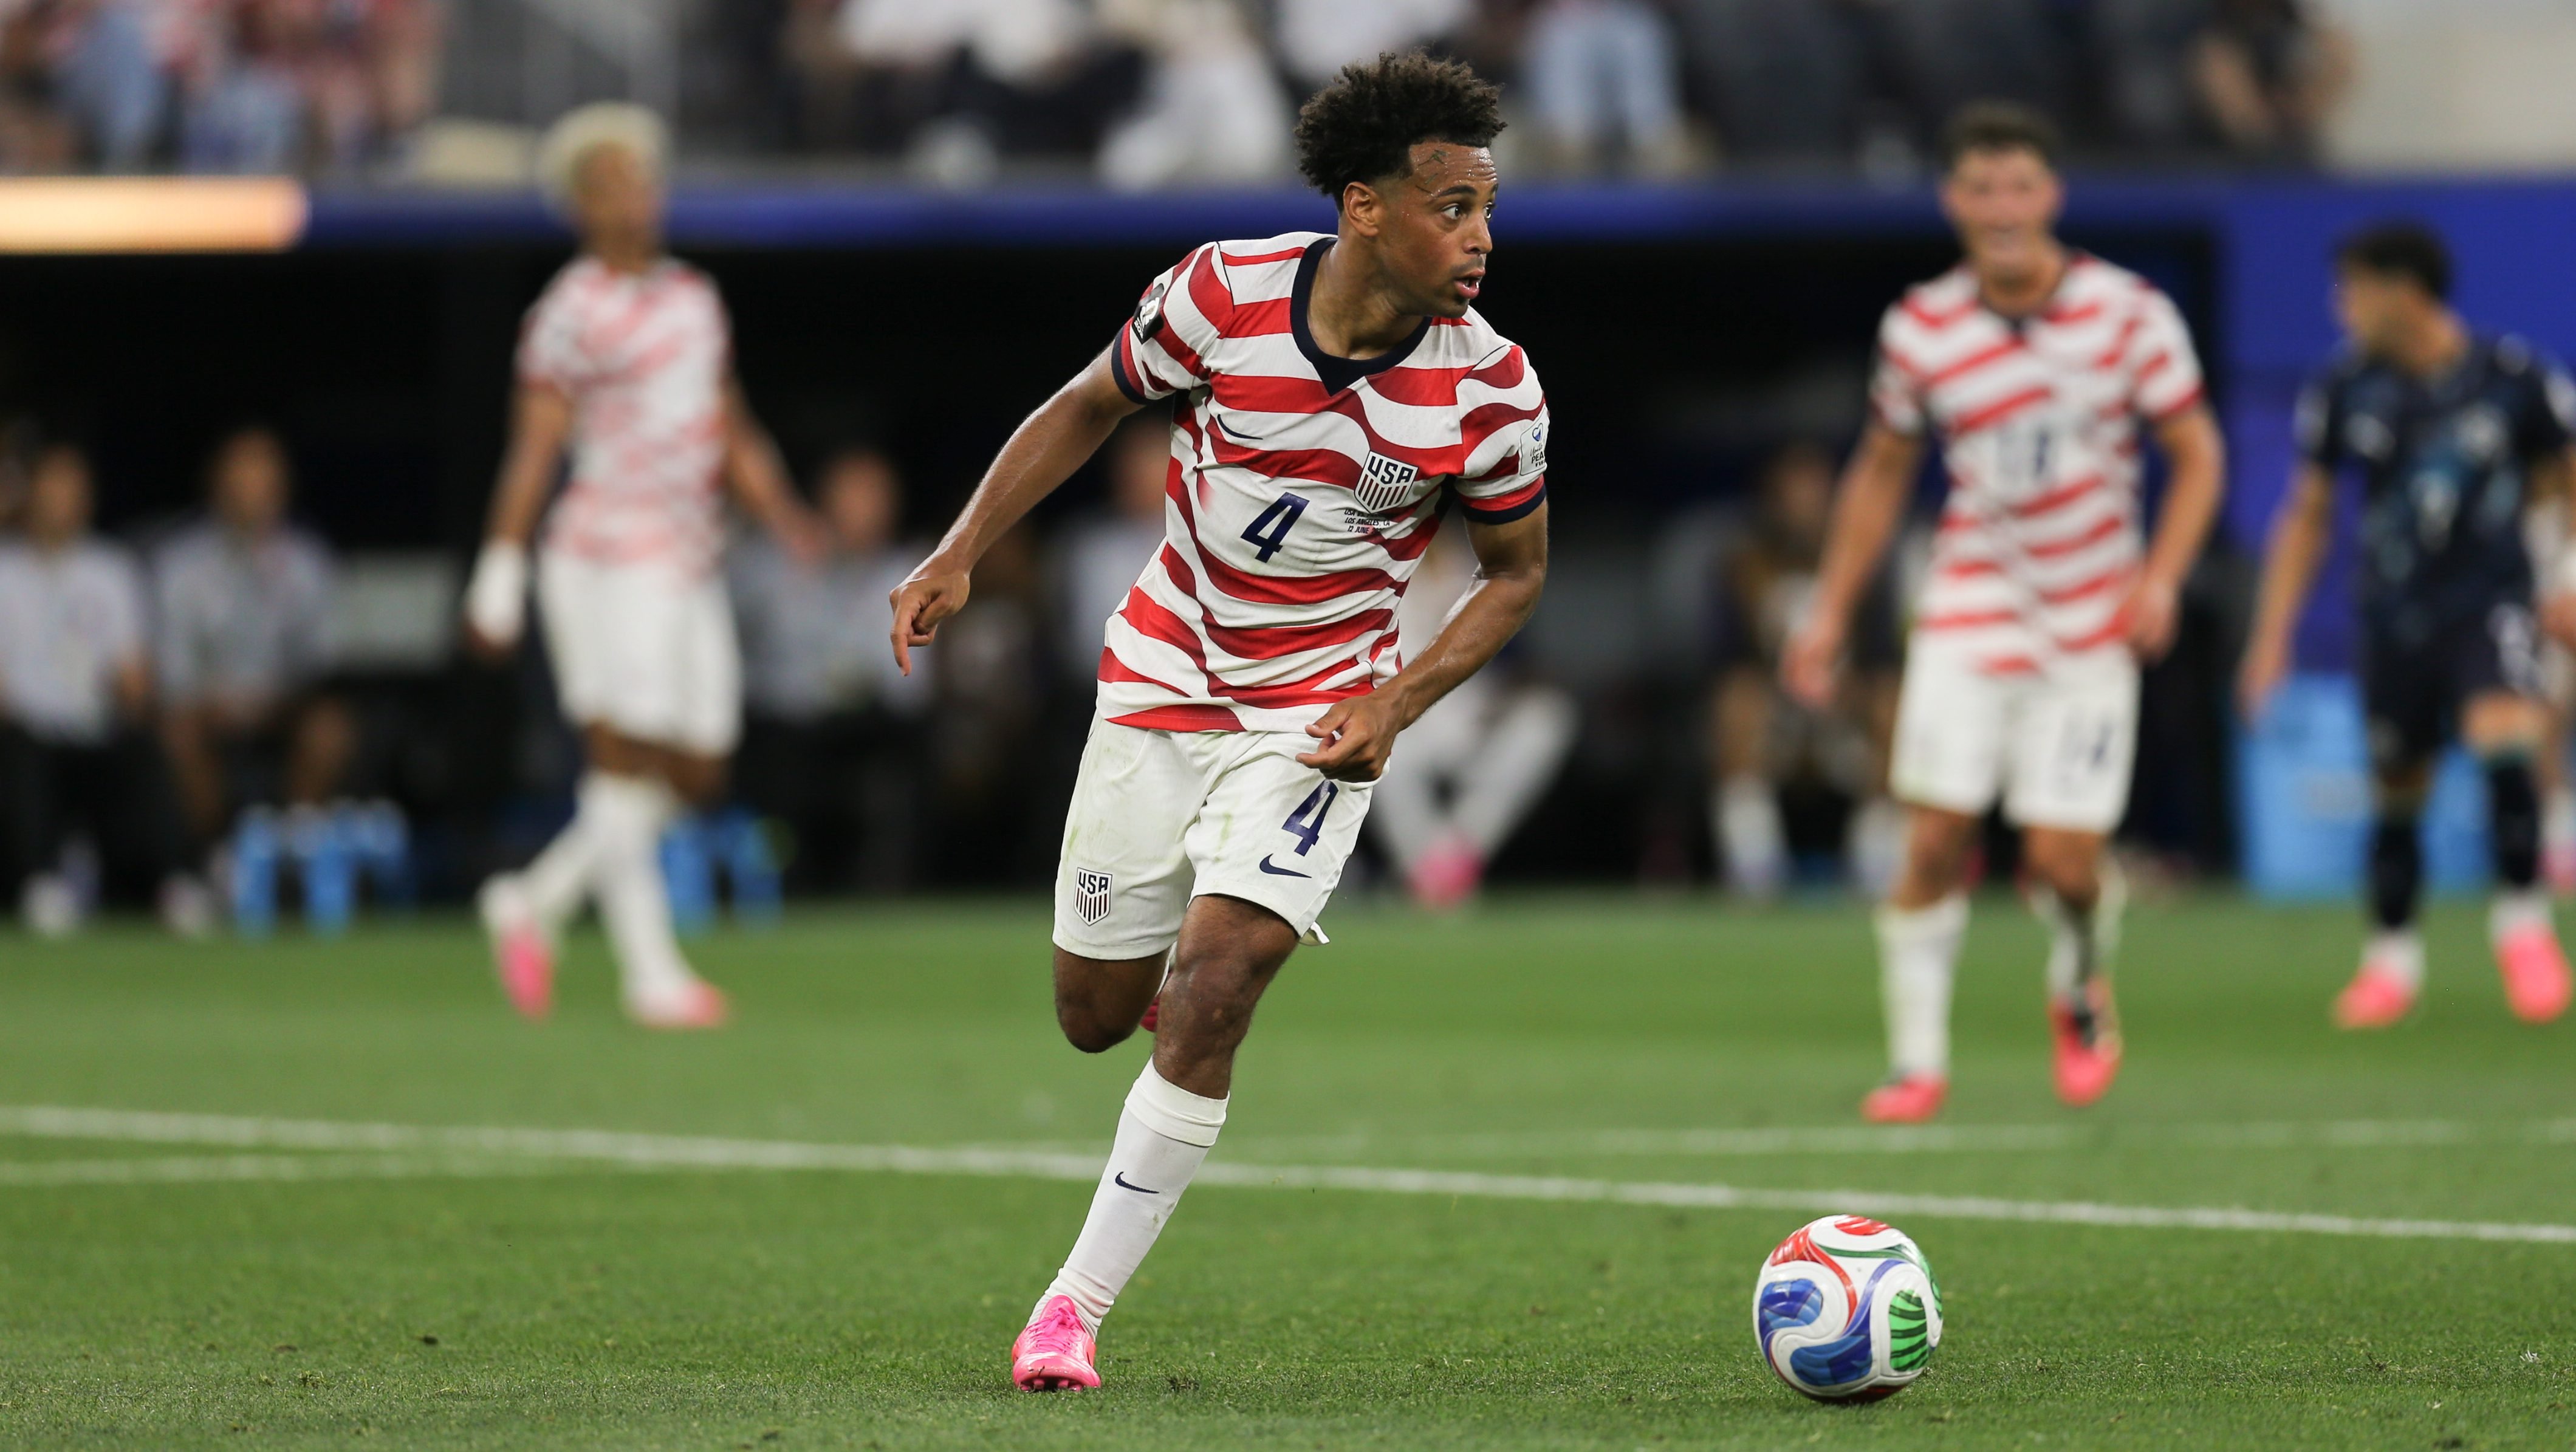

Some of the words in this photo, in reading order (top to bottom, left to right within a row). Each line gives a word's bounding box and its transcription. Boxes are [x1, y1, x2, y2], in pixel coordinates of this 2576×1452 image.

[1368, 456, 1414, 484] USA
[1240, 491, 1310, 563] 4
[1281, 779, 1339, 857] 4
[1078, 871, 1109, 894] USA
